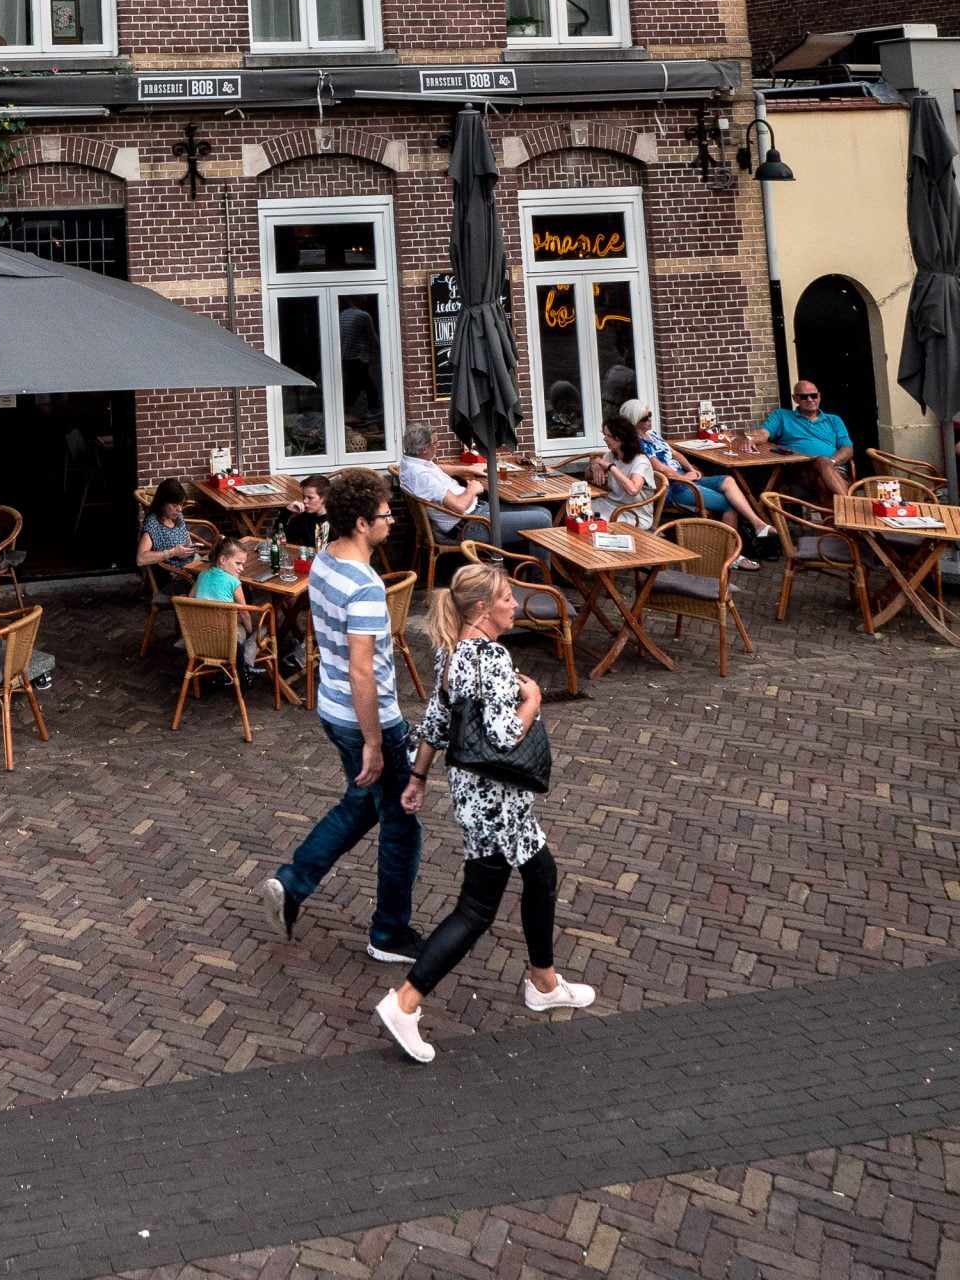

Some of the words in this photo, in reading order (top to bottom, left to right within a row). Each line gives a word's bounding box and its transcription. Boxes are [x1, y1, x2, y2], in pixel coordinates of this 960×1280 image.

[143, 83, 184, 94] BRASSERIE
[191, 80, 214, 95] BOB
[425, 76, 463, 87] BRASSERIE
[469, 73, 491, 88] BOB
